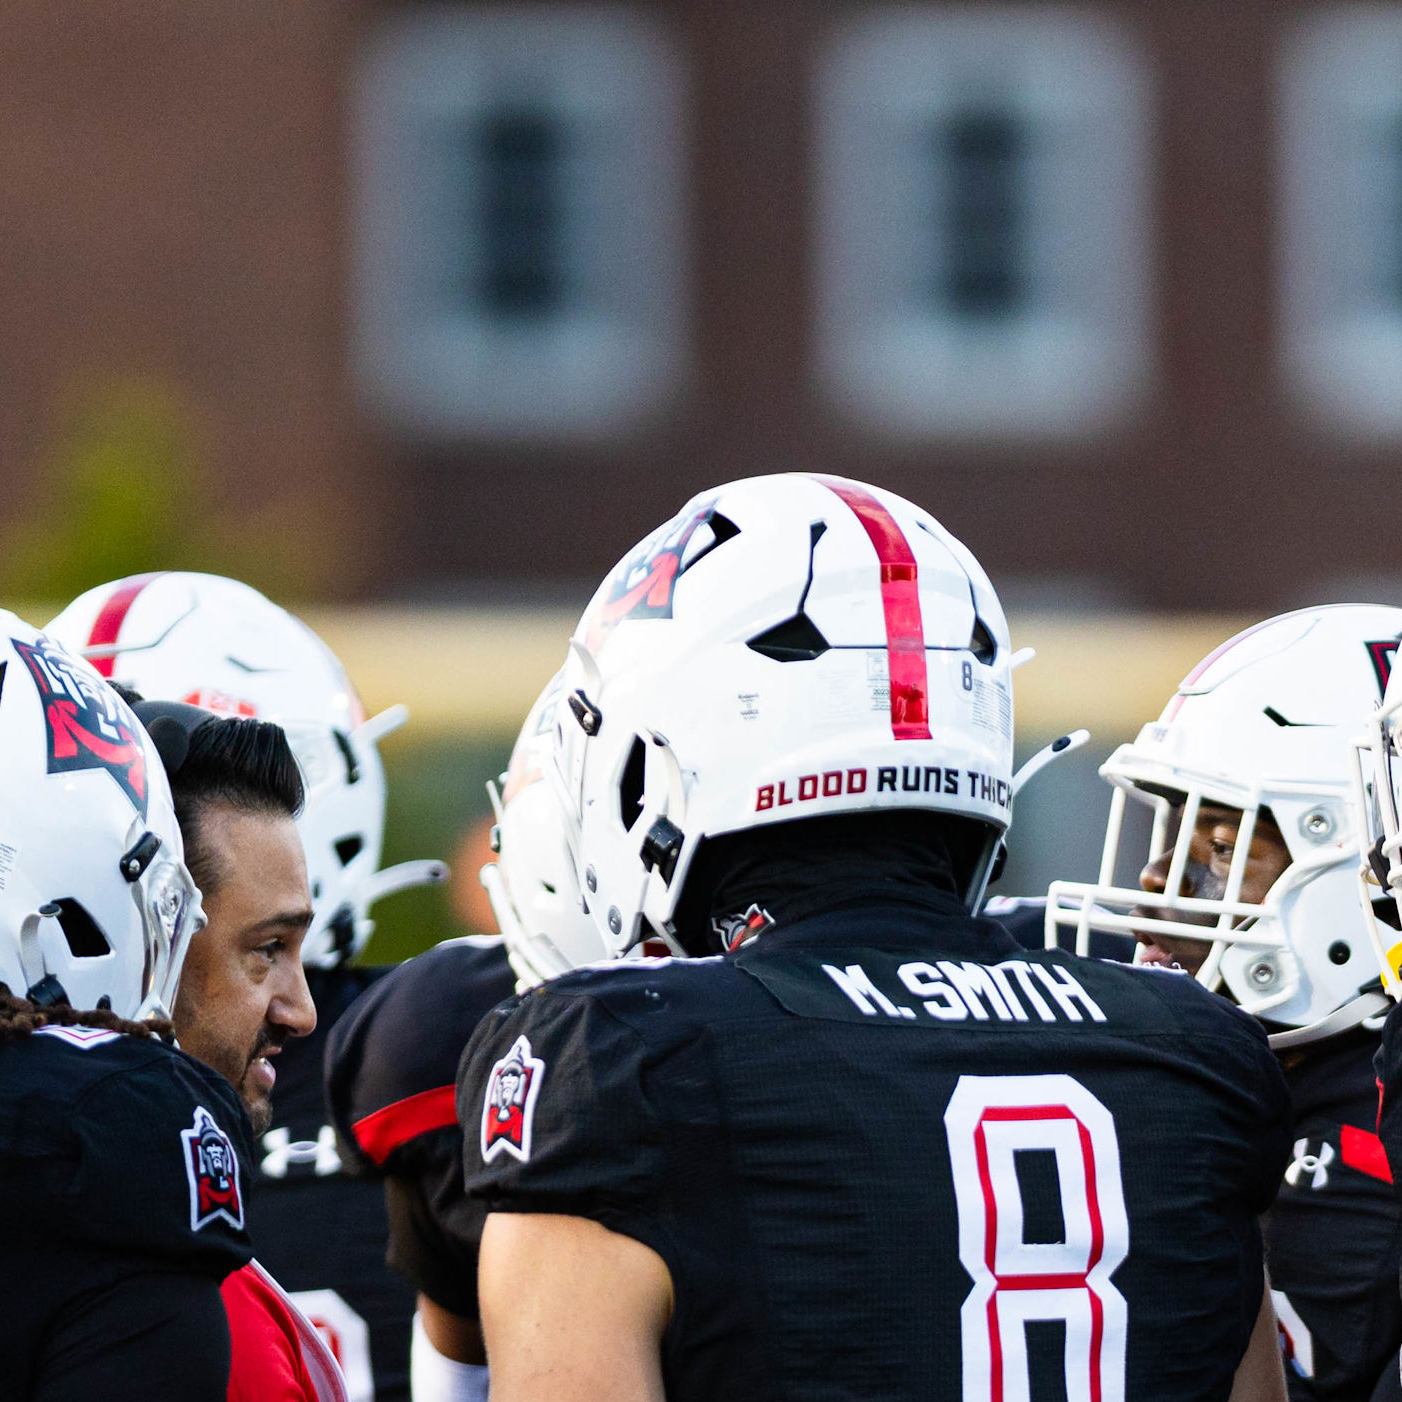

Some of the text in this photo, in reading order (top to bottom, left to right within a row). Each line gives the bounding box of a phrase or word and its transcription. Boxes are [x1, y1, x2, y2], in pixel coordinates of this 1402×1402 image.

[961, 660, 973, 692] 8
[755, 768, 868, 812] BLOOD
[877, 765, 959, 795] RUNS
[896, 959, 1109, 1023] SMITH
